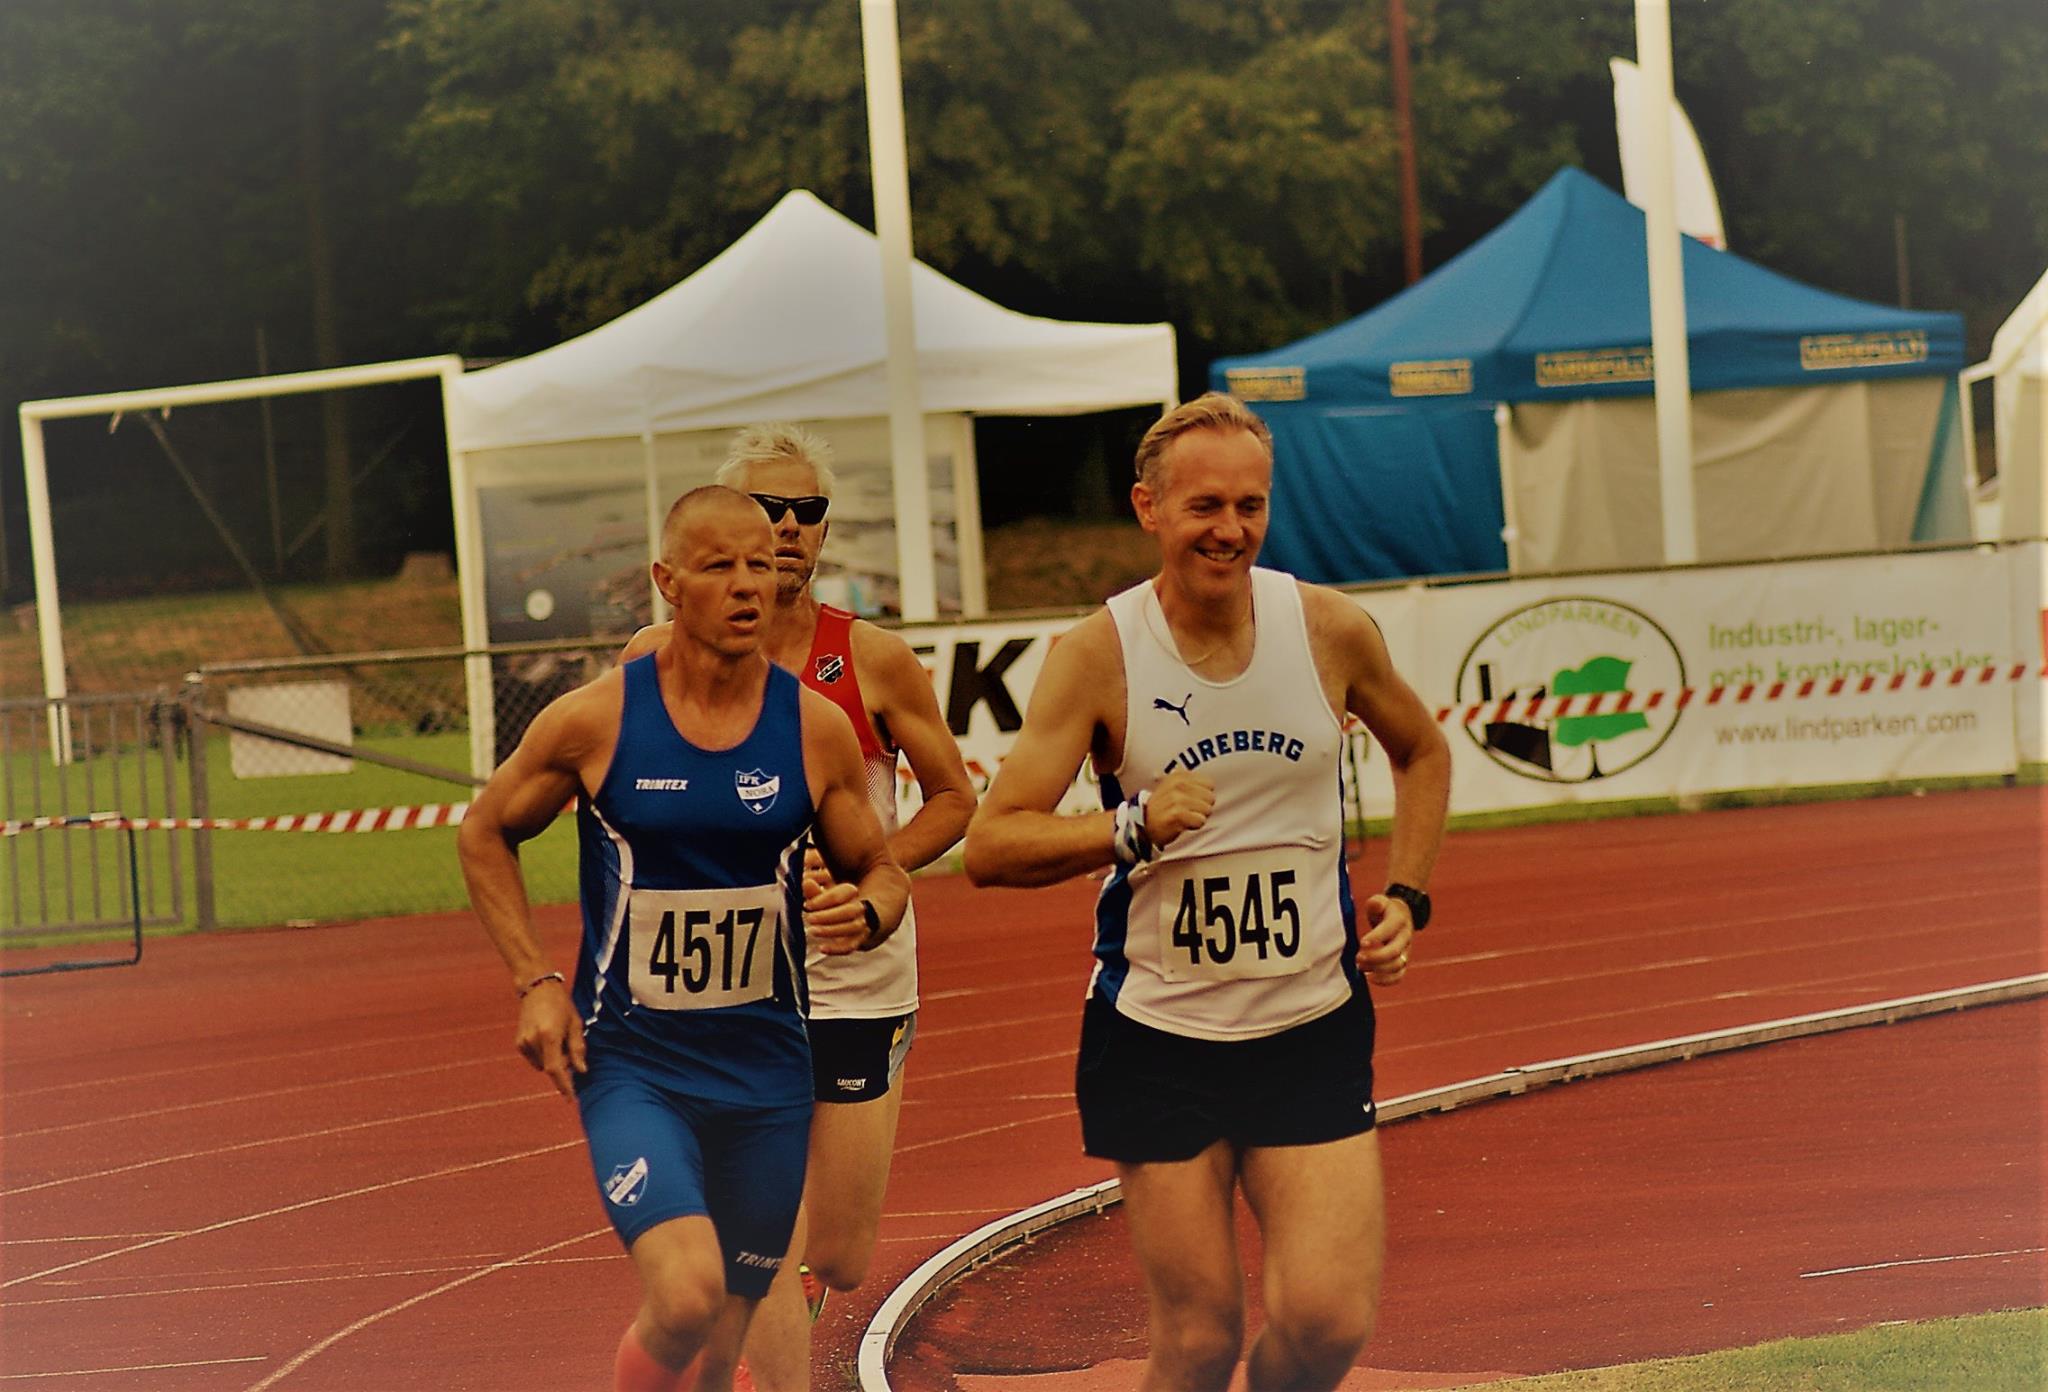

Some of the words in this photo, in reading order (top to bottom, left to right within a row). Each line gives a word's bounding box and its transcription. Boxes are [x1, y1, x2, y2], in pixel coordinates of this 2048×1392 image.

[1496, 605, 1642, 647] LINDPARKEN
[1853, 615, 1940, 645] lager-
[1714, 710, 1978, 744] www.lindparken.com
[635, 778, 689, 791] TRIMTEX
[1172, 869, 1301, 965] 4545
[649, 907, 765, 994] 4517
